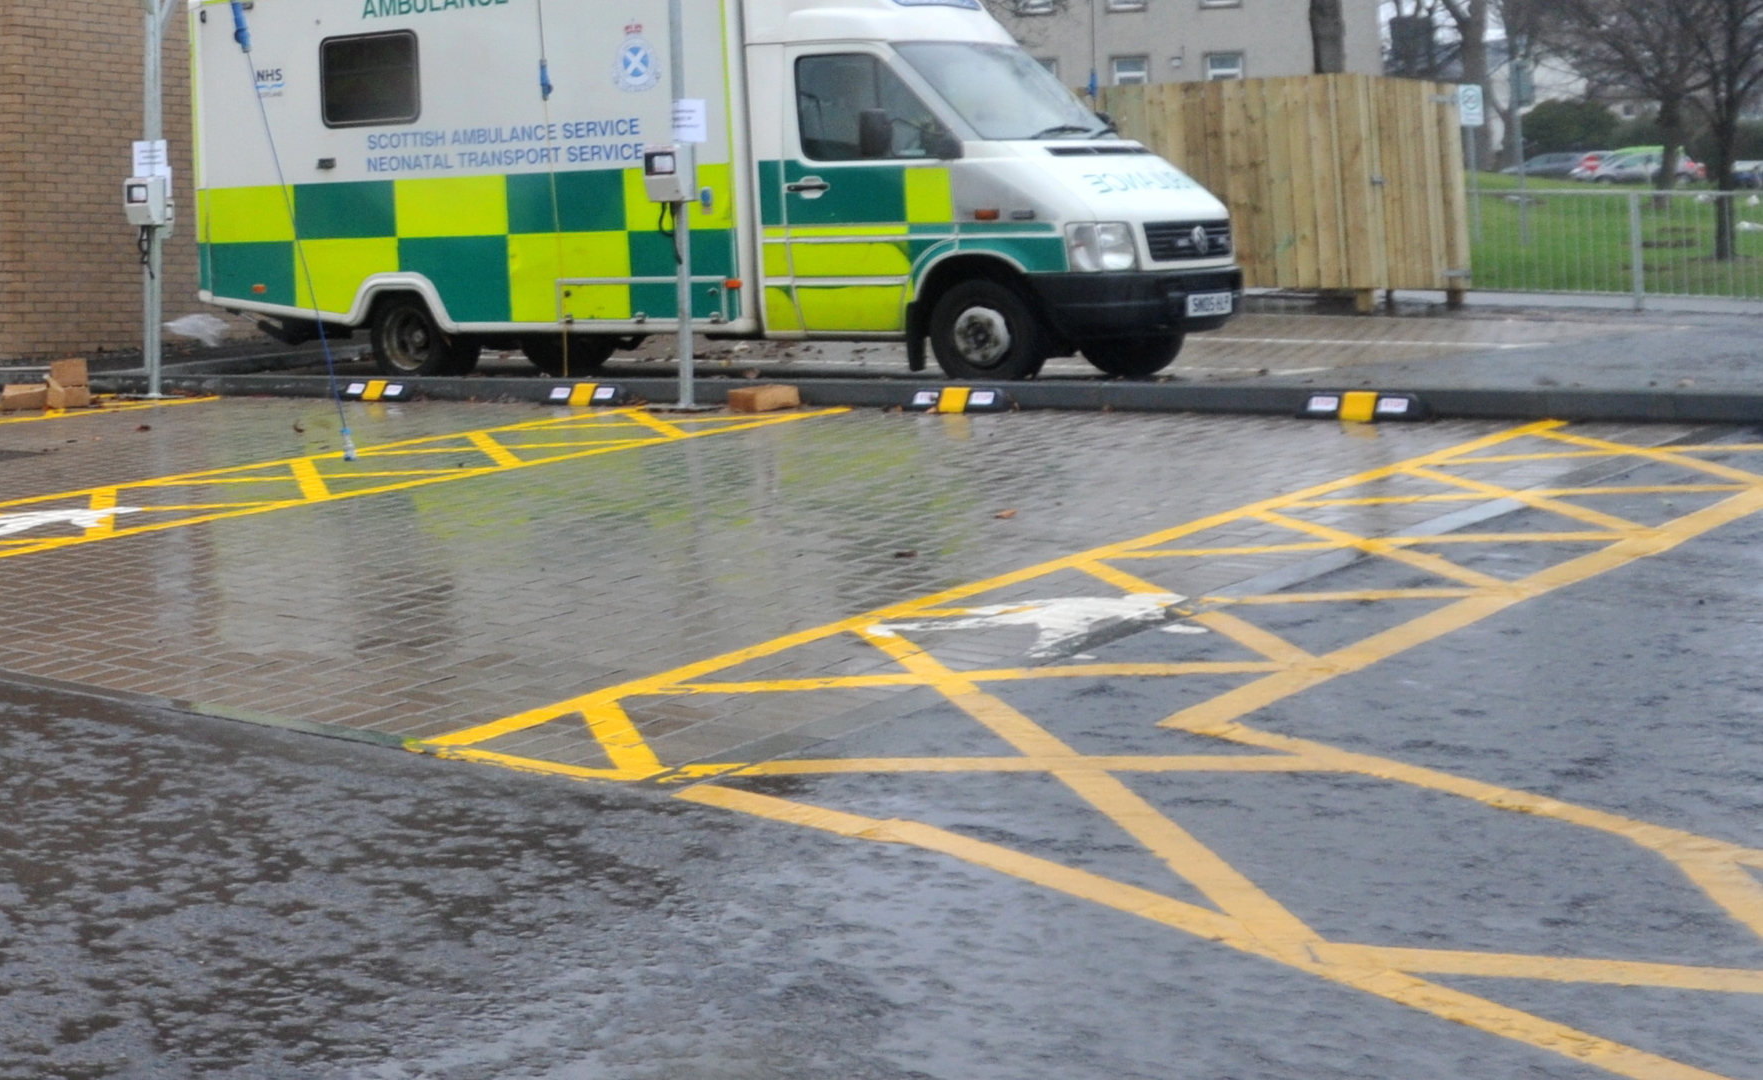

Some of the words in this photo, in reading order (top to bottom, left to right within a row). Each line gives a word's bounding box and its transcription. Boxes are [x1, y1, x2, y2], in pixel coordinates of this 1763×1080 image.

[256, 68, 282, 82] NHS
[367, 130, 445, 150] SCOTTISH
[451, 123, 556, 145] AMBULANCE
[562, 117, 640, 139] SERVICE
[366, 153, 453, 172] NEONATAL
[458, 146, 561, 168] TRANSPORT
[567, 142, 644, 163] SERVICE
